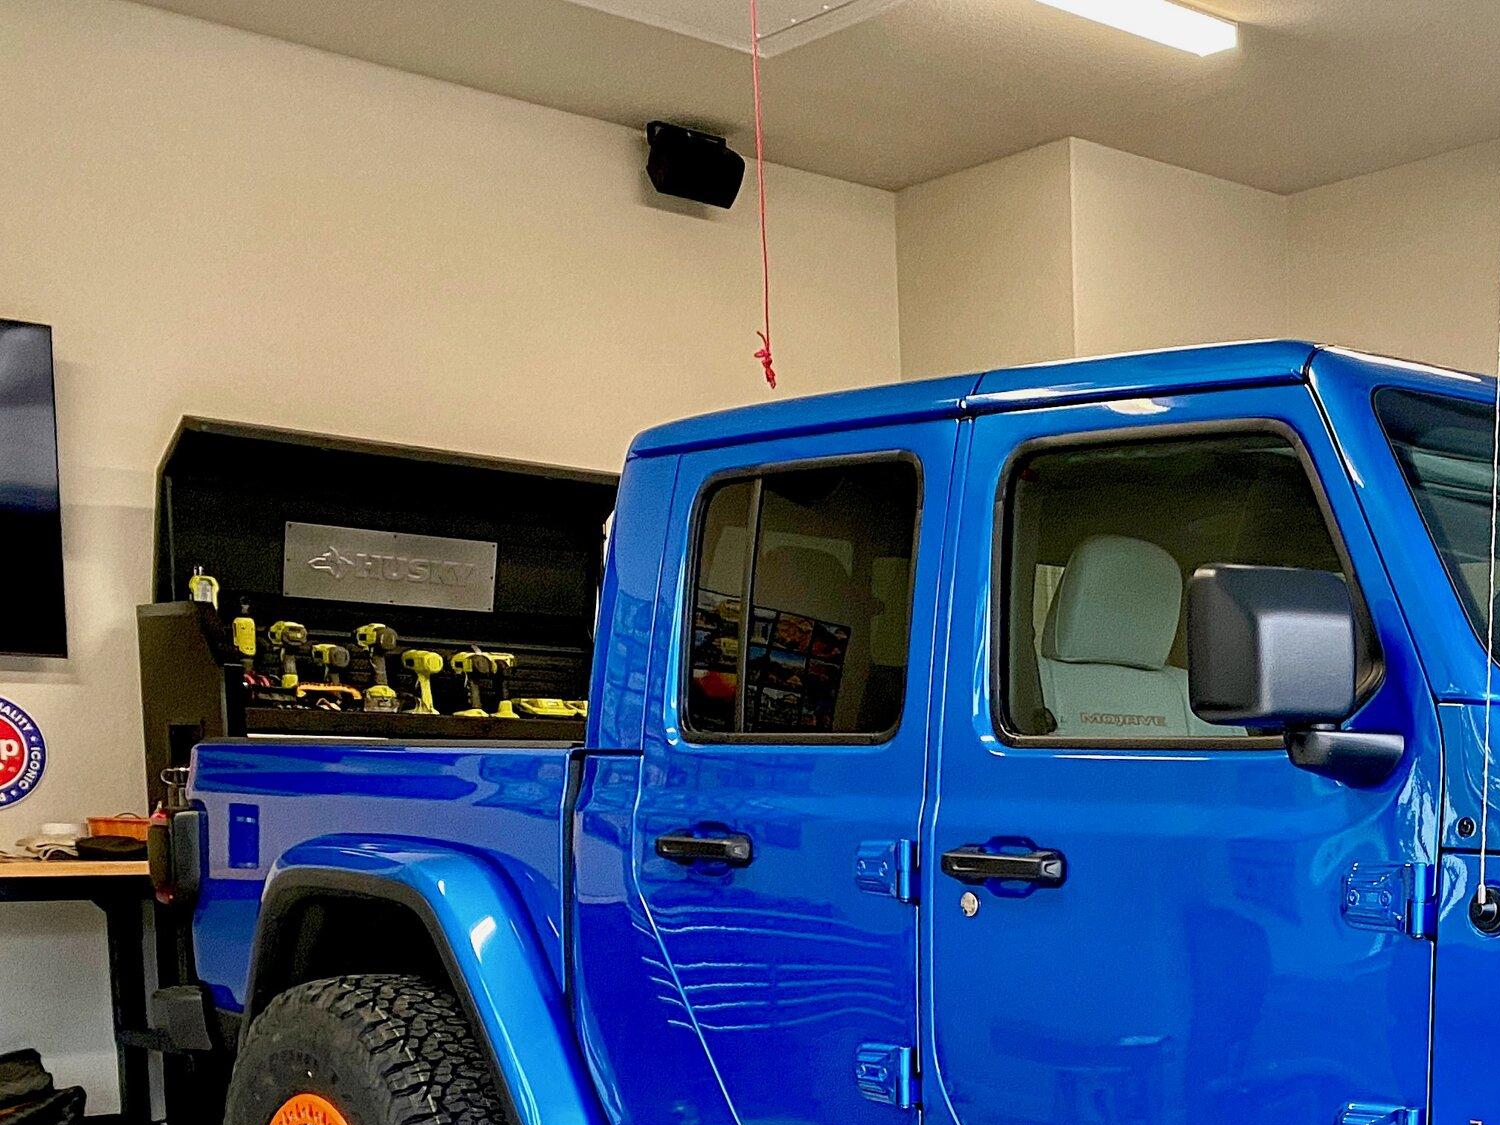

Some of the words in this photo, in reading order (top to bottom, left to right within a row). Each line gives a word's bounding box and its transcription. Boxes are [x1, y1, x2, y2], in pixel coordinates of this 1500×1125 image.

[354, 552, 476, 588] HUSKY
[1080, 712, 1166, 727] MOJAVE
[19, 746, 42, 790] ICONIC
